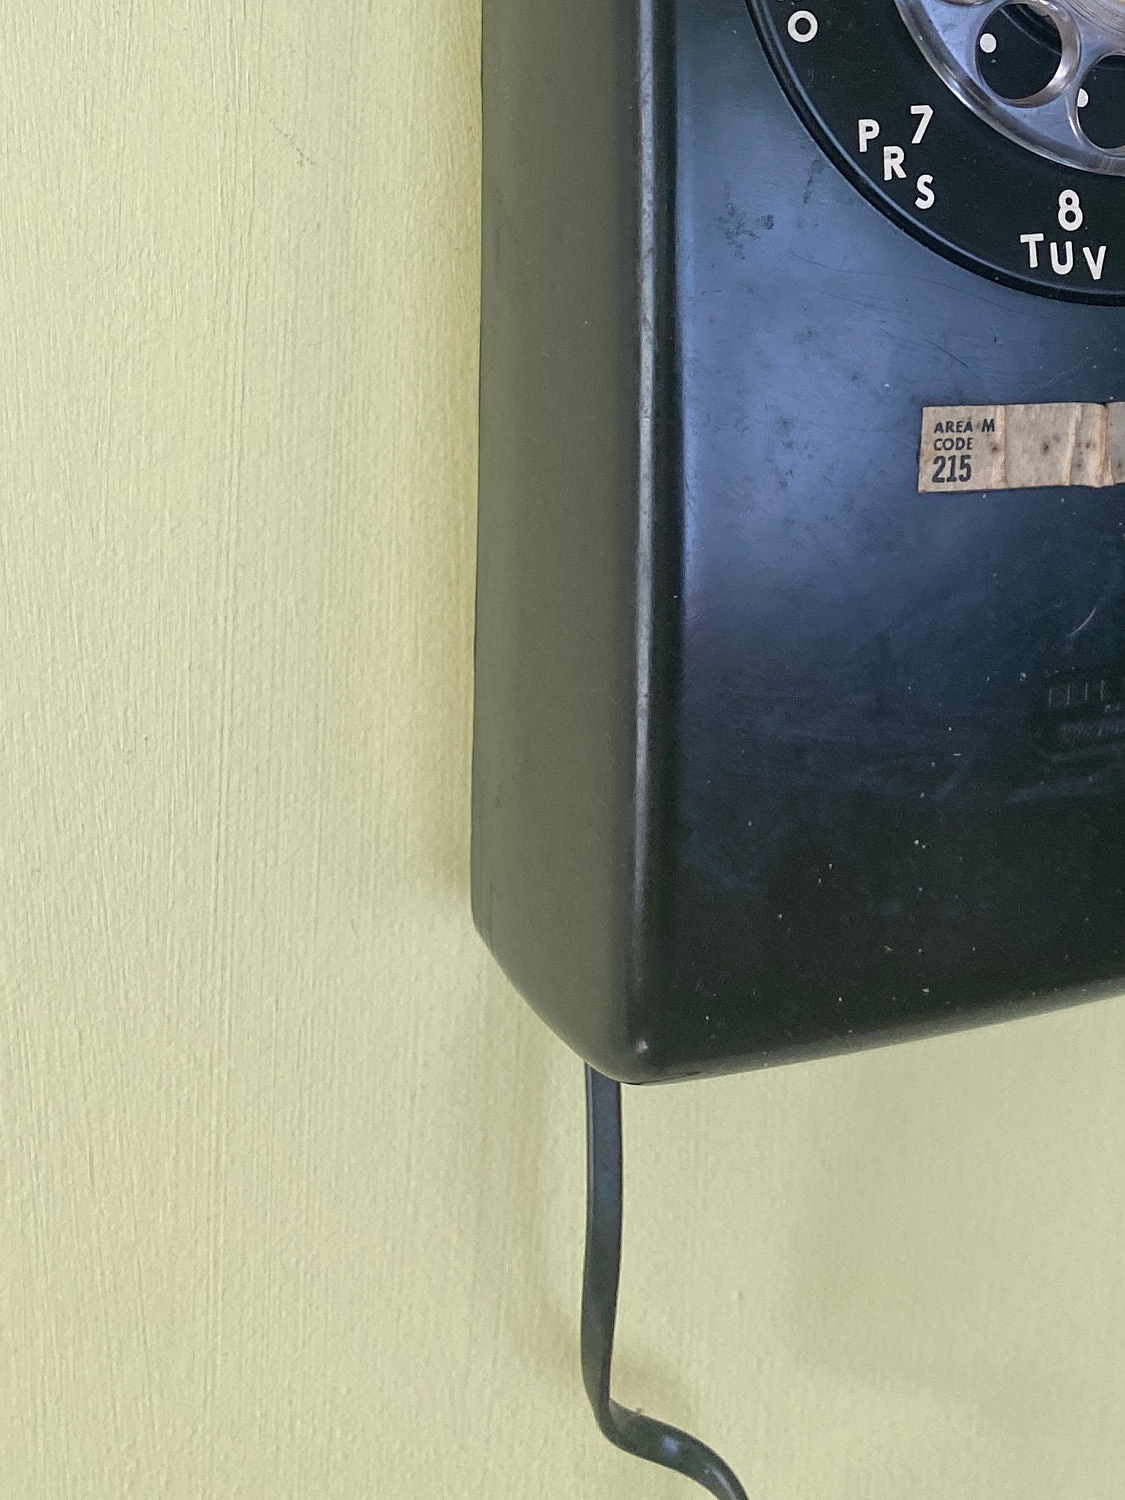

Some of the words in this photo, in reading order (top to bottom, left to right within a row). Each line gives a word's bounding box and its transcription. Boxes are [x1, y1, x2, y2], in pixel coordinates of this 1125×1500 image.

[910, 104, 934, 144] 7
[858, 118, 935, 210] PRS
[1057, 189, 1084, 232] 8
[1019, 233, 1107, 281] TUV
[933, 419, 973, 434] AREA
[981, 418, 995, 433] M
[933, 437, 973, 452] CODE
[931, 455, 972, 483] 215
